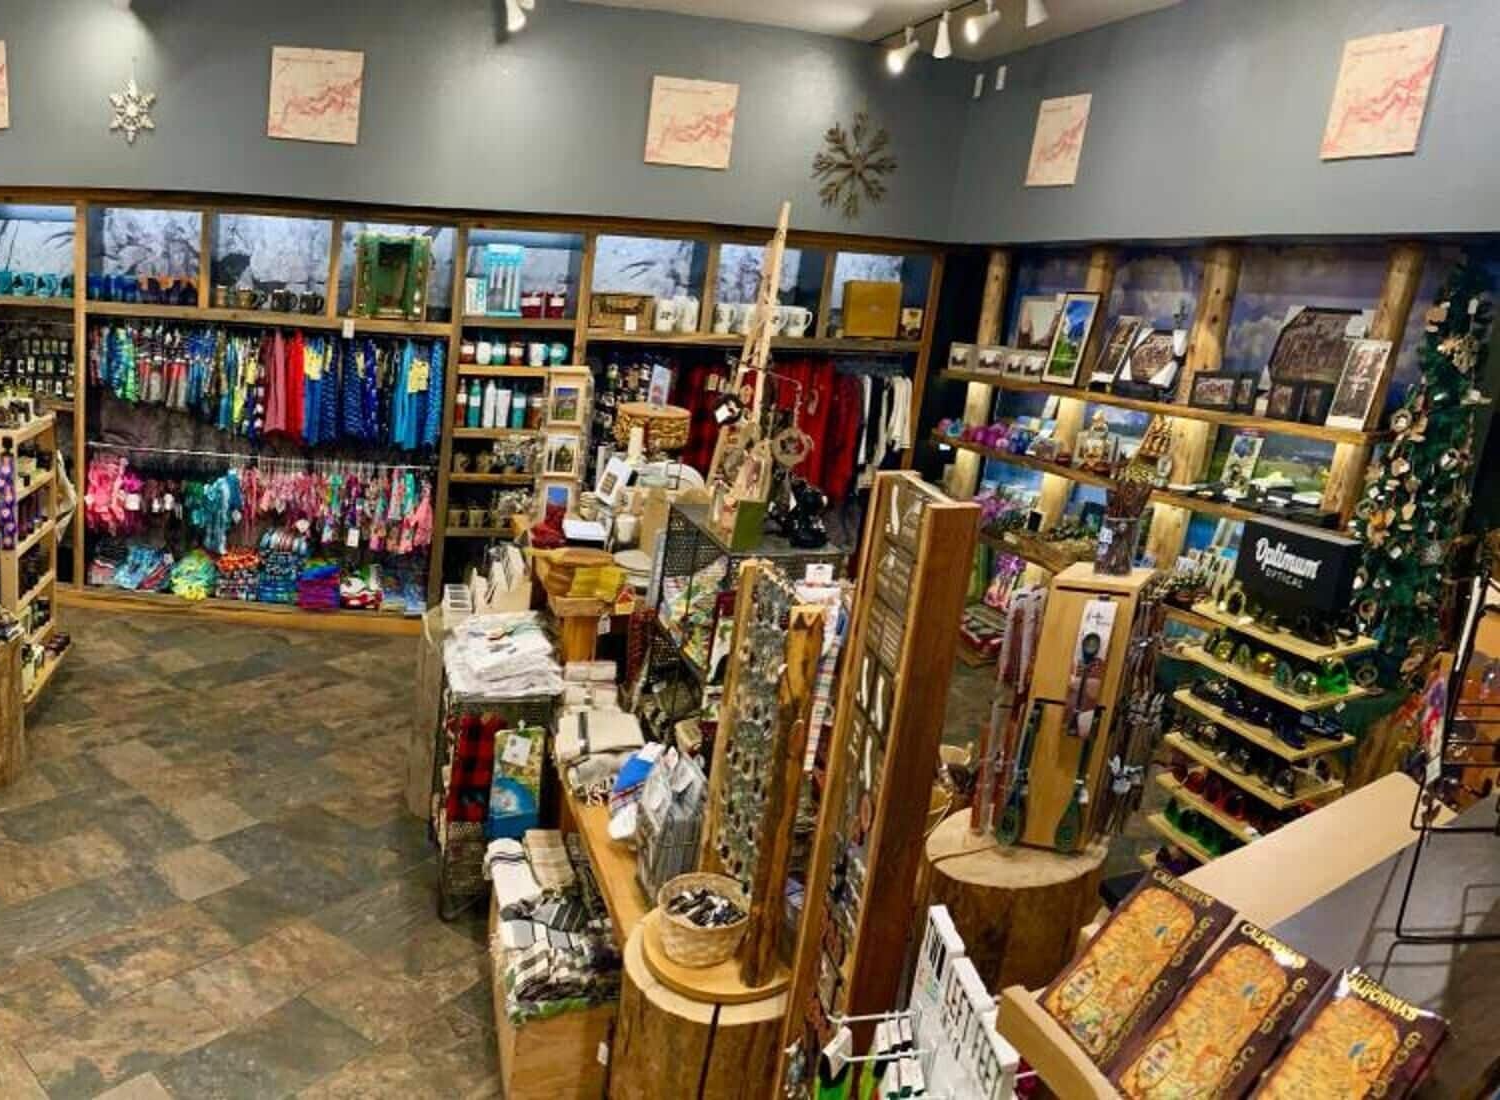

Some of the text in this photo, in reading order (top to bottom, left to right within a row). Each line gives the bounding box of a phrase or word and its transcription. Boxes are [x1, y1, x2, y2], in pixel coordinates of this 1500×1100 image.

[1255, 538, 1322, 579] Optimum
[945, 967, 975, 1043] LEFT
[1260, 977, 1309, 1034] GOLD
